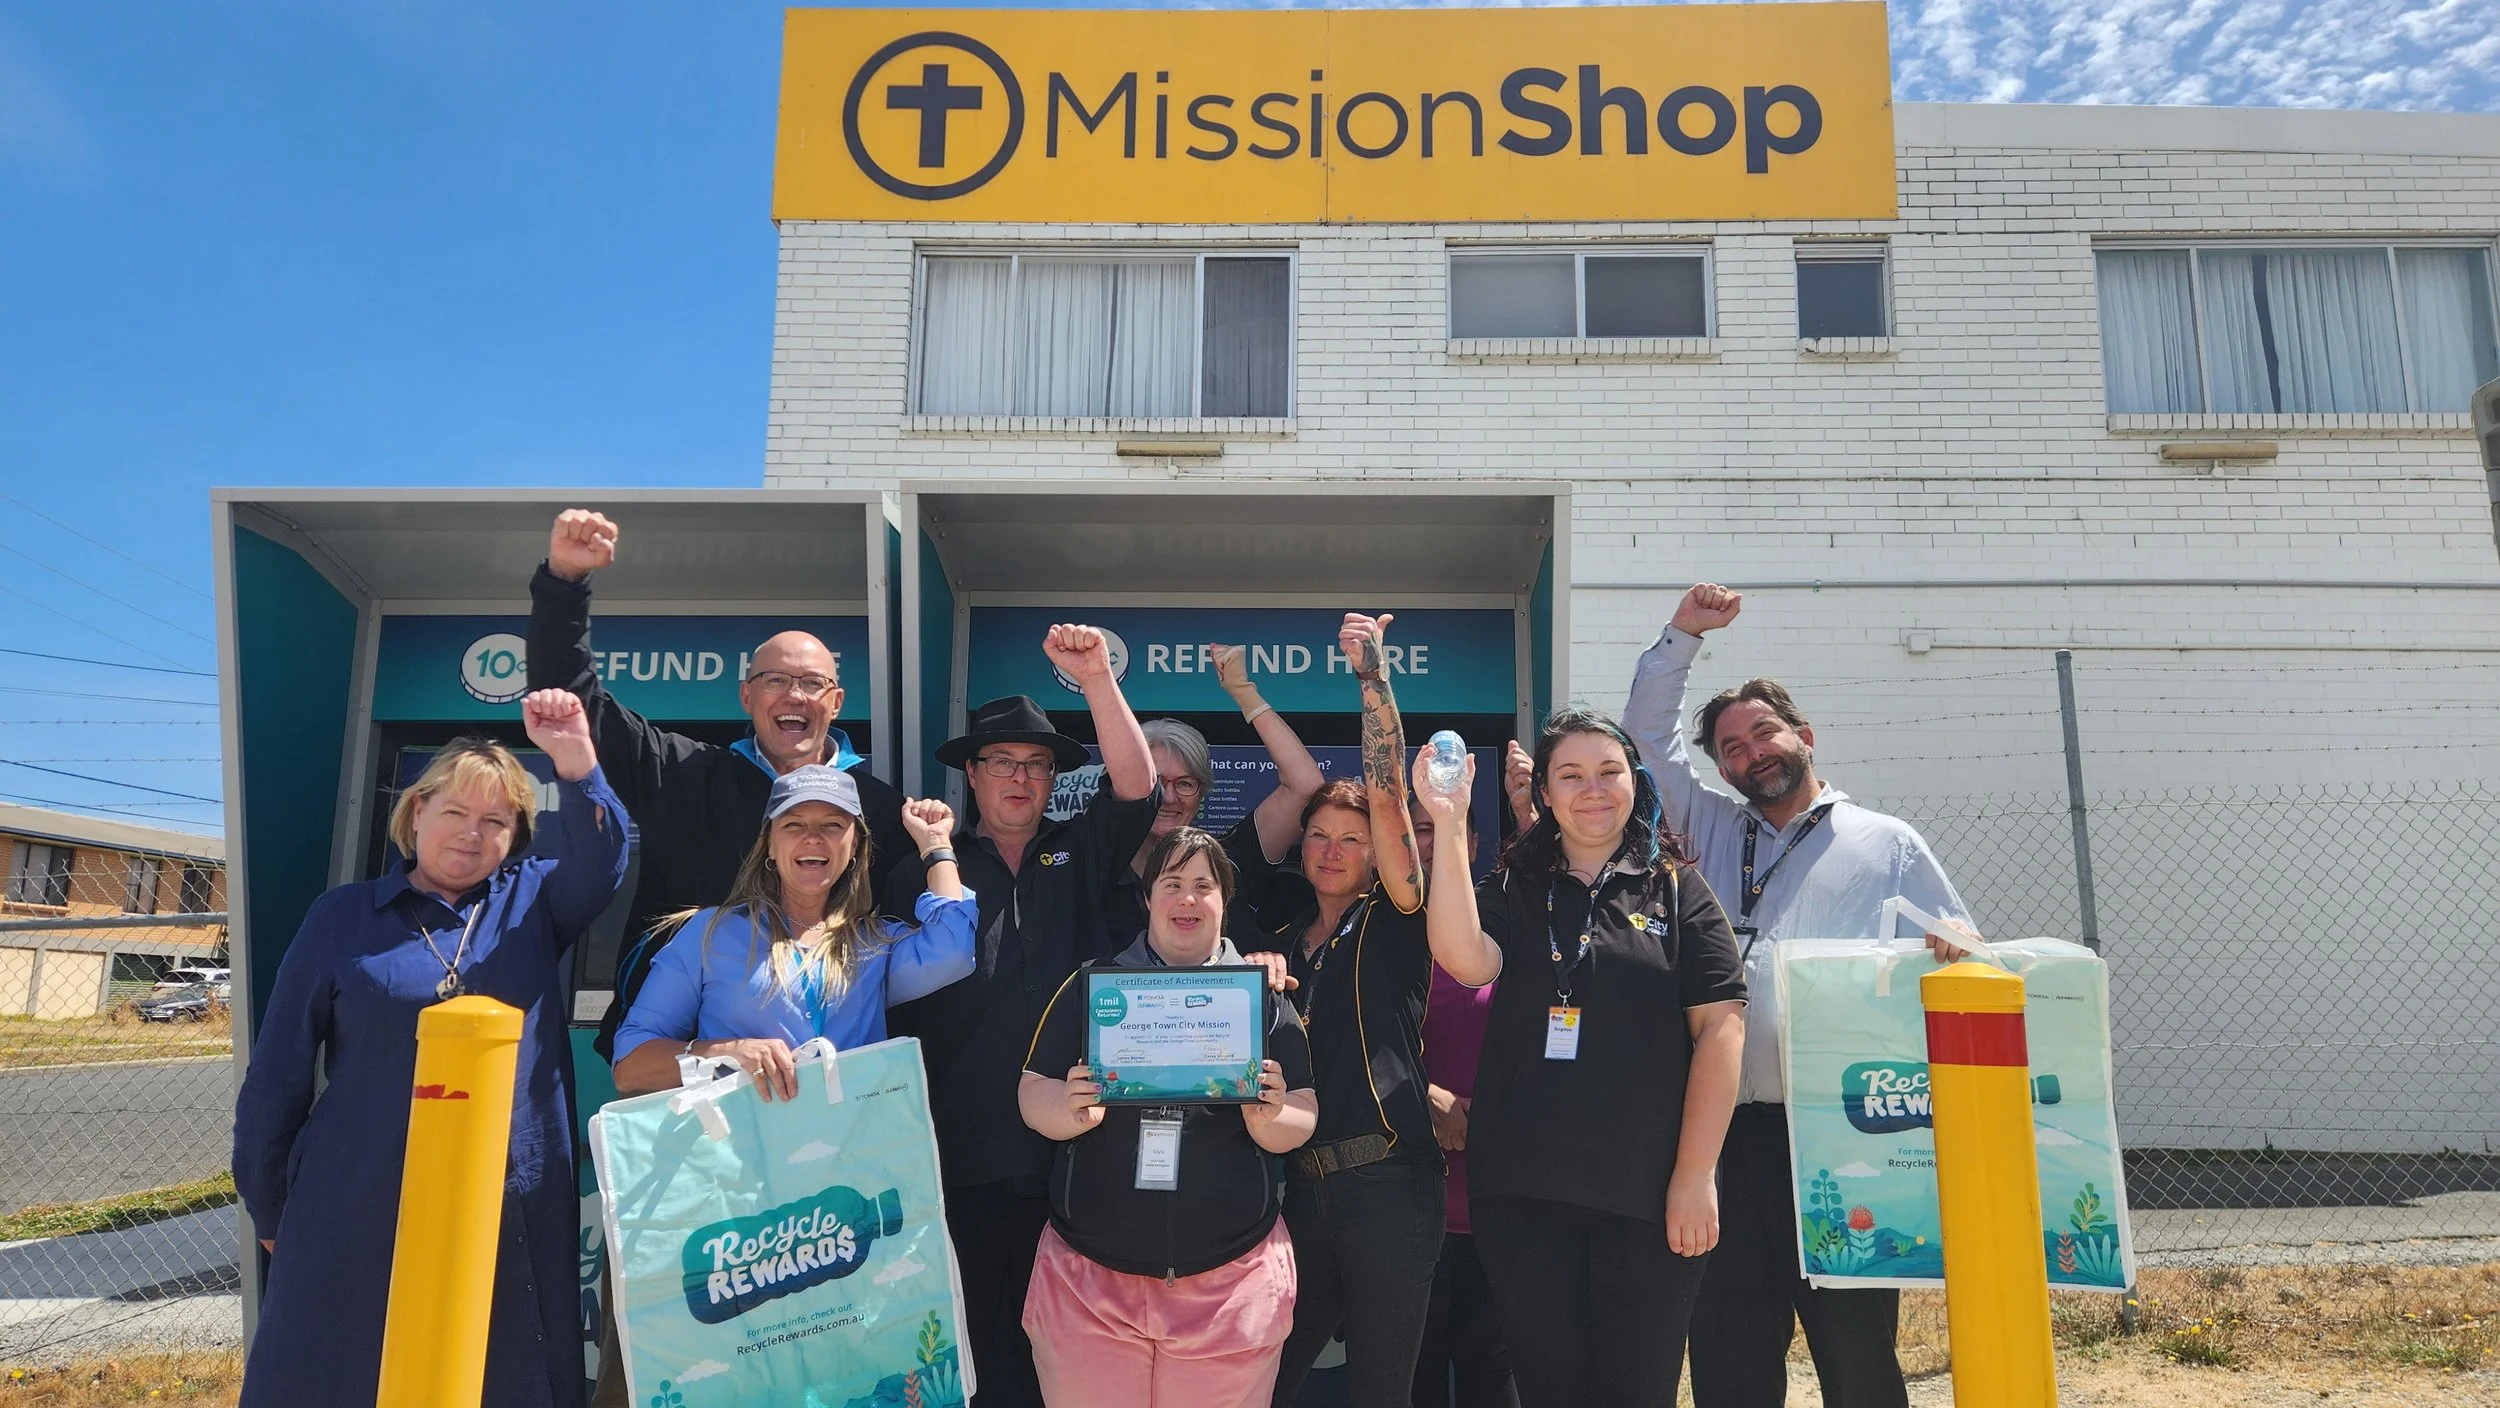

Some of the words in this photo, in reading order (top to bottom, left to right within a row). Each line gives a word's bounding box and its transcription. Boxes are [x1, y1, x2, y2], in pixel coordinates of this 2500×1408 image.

[1147, 644, 1312, 674] REFND
[1327, 645, 1429, 674] HRE
[1209, 759, 1232, 770] hat
[1234, 761, 1256, 770] can
[1647, 917, 1668, 932] City
[1115, 977, 1163, 987] Certificate
[1164, 976, 1174, 985] of
[1176, 976, 1235, 985] Achievement
[1099, 996, 1119, 1006] 1mil
[1120, 1022, 1151, 1032] George
[1153, 1022, 1177, 1030] Town
[1179, 1020, 1195, 1031] City
[1198, 1020, 1231, 1029] Mission
[1898, 1147, 1912, 1156] For
[702, 1206, 841, 1272] Recycle
[746, 1329, 760, 1338] For
[763, 1321, 787, 1333] more
[788, 1315, 808, 1326] info,
[810, 1306, 836, 1321] check
[837, 1303, 853, 1312] out
[736, 1312, 865, 1356] RecycleRewards.com.au
